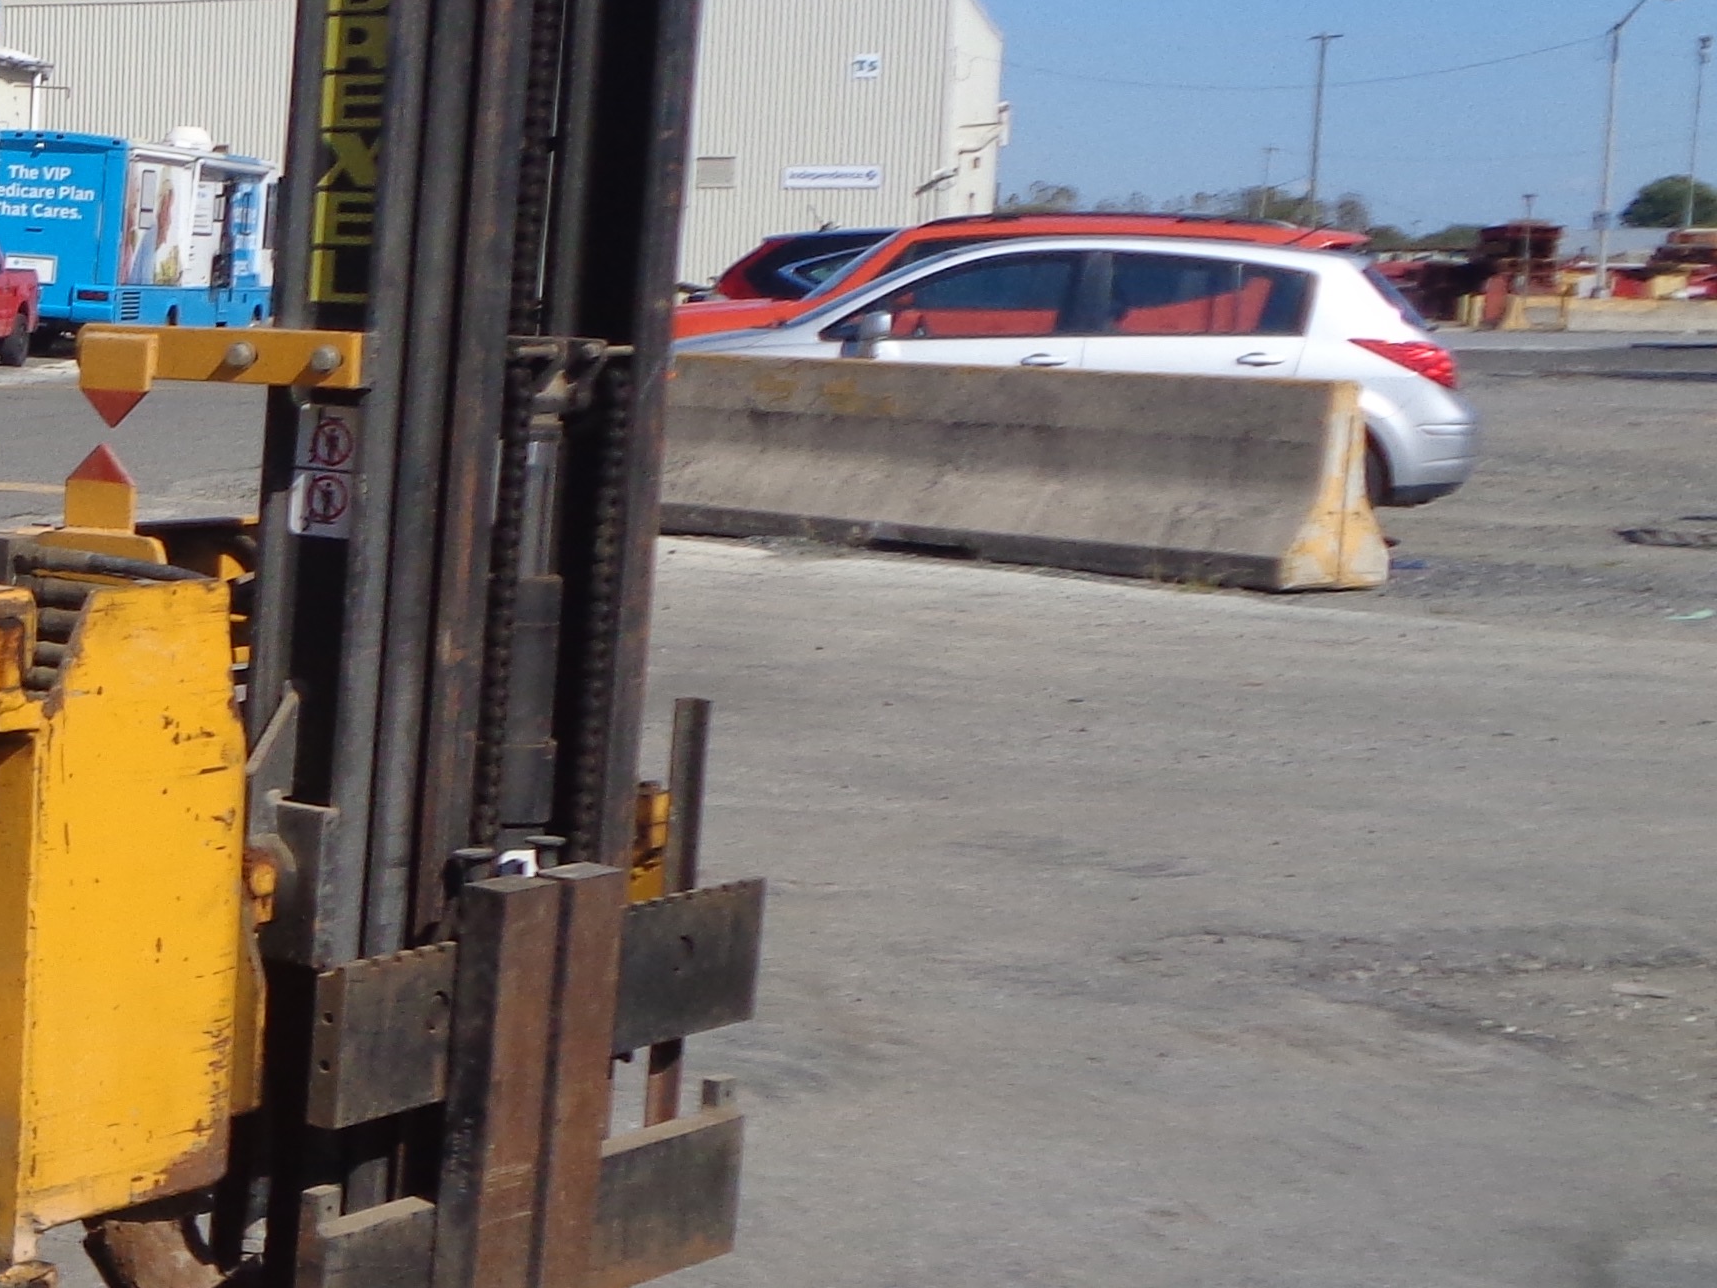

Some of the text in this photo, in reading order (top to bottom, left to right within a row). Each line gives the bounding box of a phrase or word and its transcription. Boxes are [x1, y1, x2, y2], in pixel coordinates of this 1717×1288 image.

[9, 165, 71, 180] The VIP
[60, 186, 94, 200] Plan
[33, 204, 82, 219] Cares.
